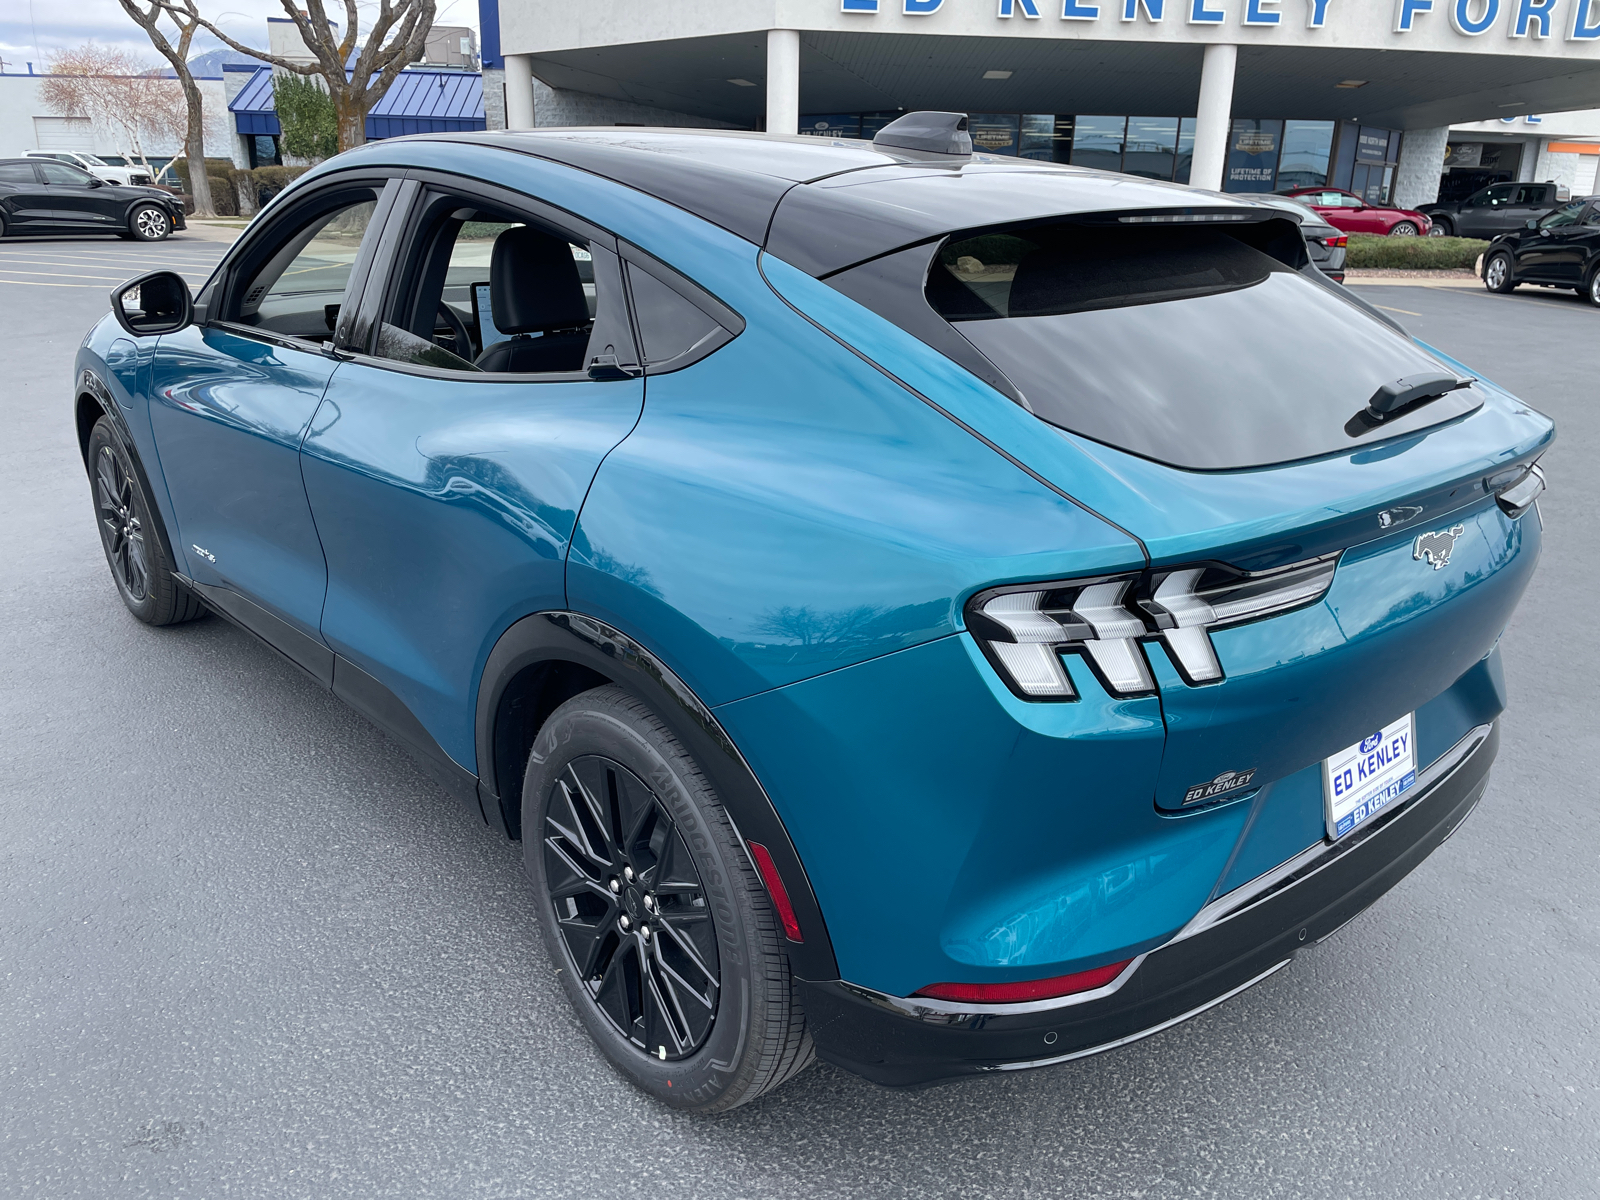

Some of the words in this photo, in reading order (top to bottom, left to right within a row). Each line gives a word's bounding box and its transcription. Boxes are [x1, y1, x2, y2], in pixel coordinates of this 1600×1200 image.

[1392, 0, 1600, 41] FORD
[1334, 767, 1353, 797] ED
[1357, 732, 1408, 783] KENLEY
[1186, 788, 1204, 802] ED
[1205, 772, 1255, 796] KENLEY
[1353, 806, 1366, 824] ED
[1367, 780, 1401, 815] KENLEY
[651, 764, 744, 966] BRIDGESTONE
